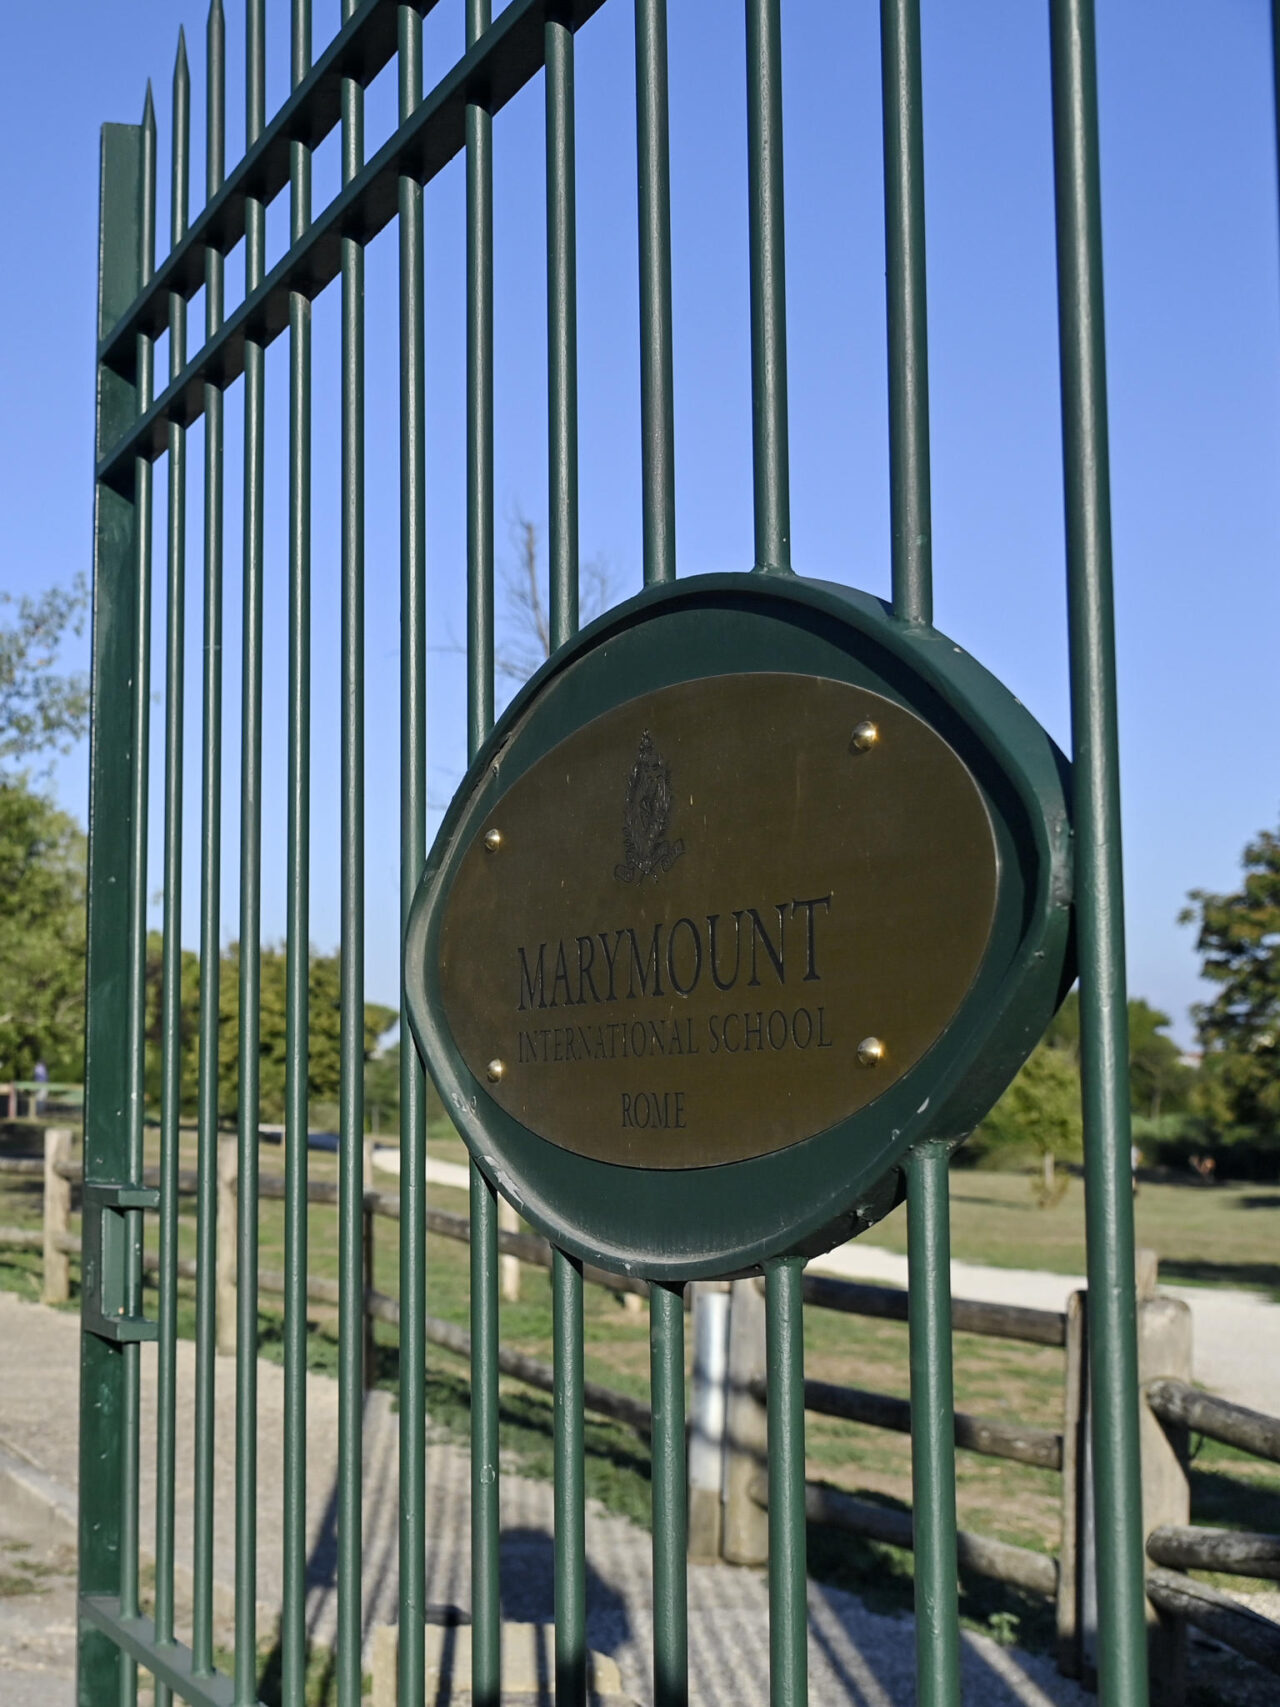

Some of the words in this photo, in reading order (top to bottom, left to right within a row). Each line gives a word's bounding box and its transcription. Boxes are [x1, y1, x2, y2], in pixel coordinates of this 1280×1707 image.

[518, 895, 832, 1010] MARYMOUNT
[518, 1016, 699, 1063] INTERNATIONAL
[709, 1007, 832, 1054] SCHOOL
[621, 1092, 686, 1128] ROME
